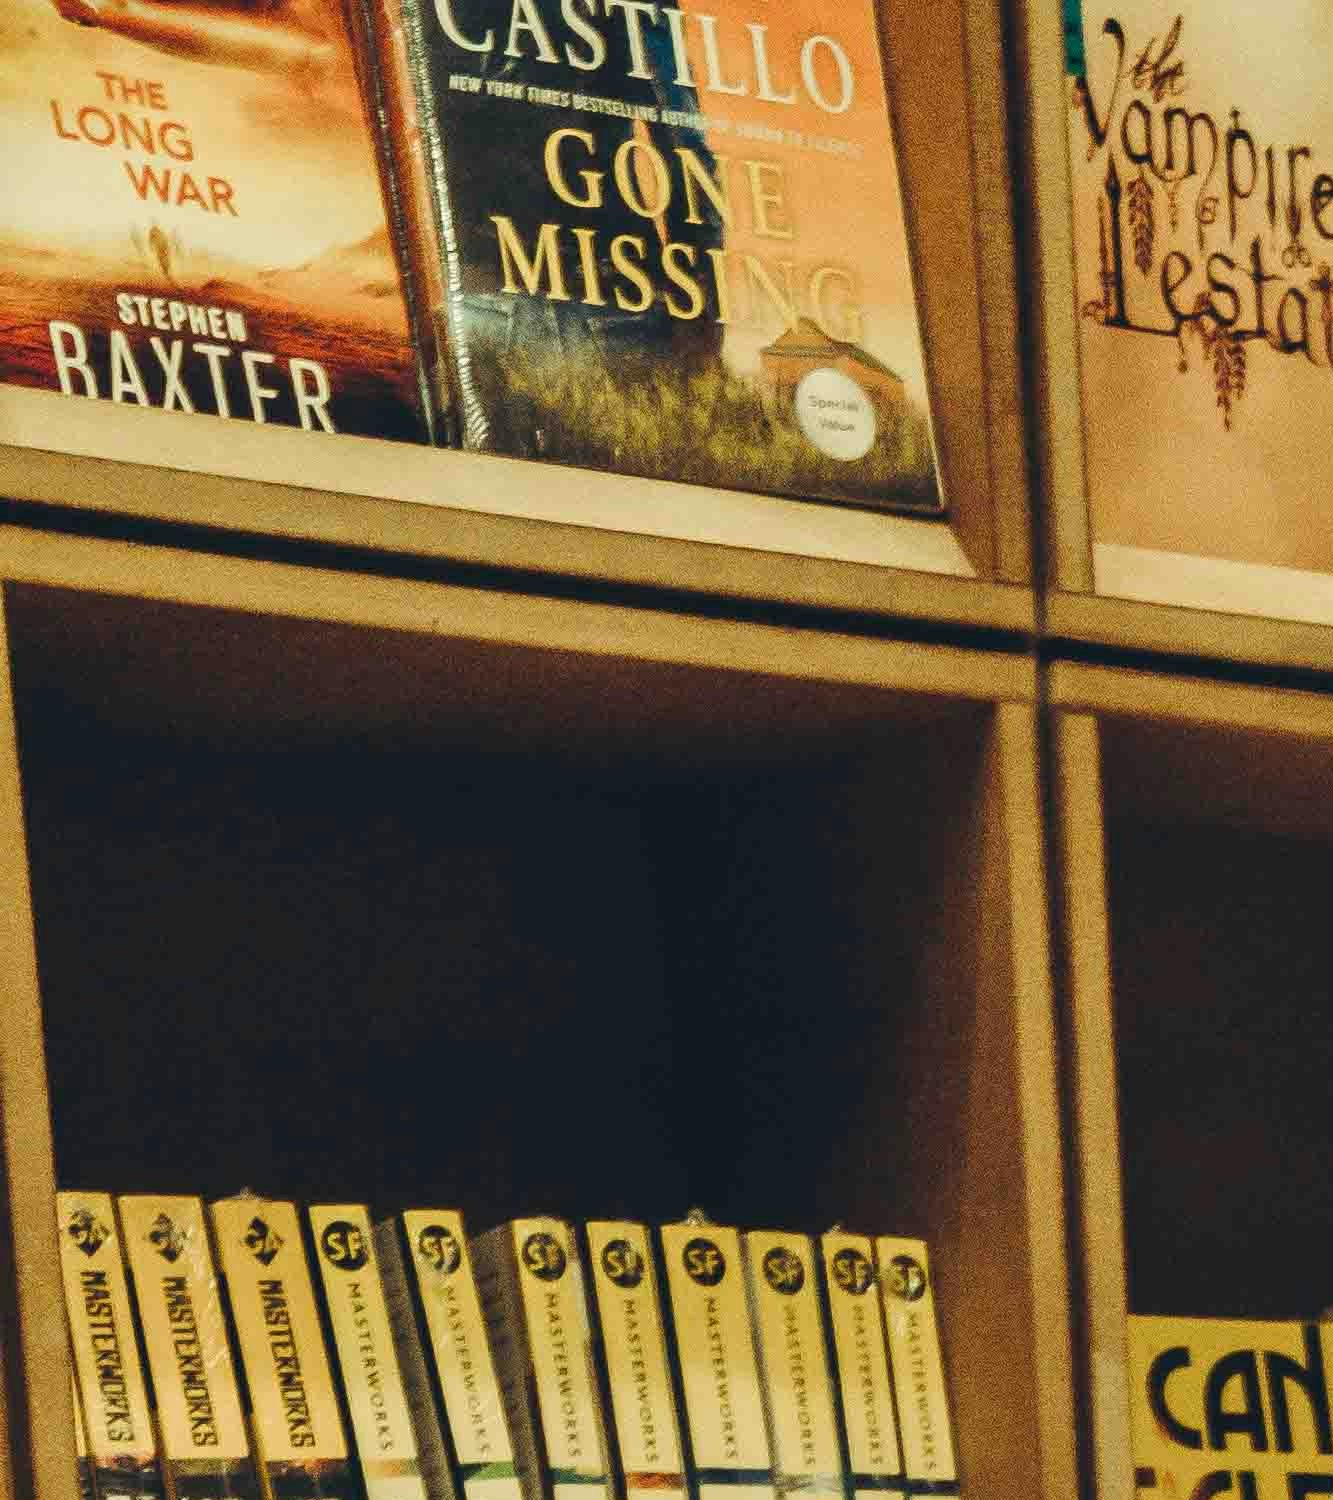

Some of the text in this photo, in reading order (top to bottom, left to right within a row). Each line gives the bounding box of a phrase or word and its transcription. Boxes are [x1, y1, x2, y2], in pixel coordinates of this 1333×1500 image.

[96, 69, 169, 112] THE
[432, 0, 857, 115] CASTILLO
[448, 73, 481, 93] NEW
[486, 79, 523, 99] YORK
[527, 86, 571, 108] TIMES
[572, 92, 658, 123] BESTSELLING
[50, 99, 195, 162] LONG
[543, 127, 794, 241] GONE
[123, 160, 240, 217] WAR
[115, 292, 250, 343] STEPHEN
[489, 215, 865, 344] MISSING
[47, 319, 338, 434] BAXTER
[81, 1270, 136, 1444] MASTERWORKS
[163, 1275, 220, 1448] MASTERWORKS
[257, 1279, 317, 1449] MASTERWORKS
[326, 1227, 393, 1452] SF MASTERWORKS
